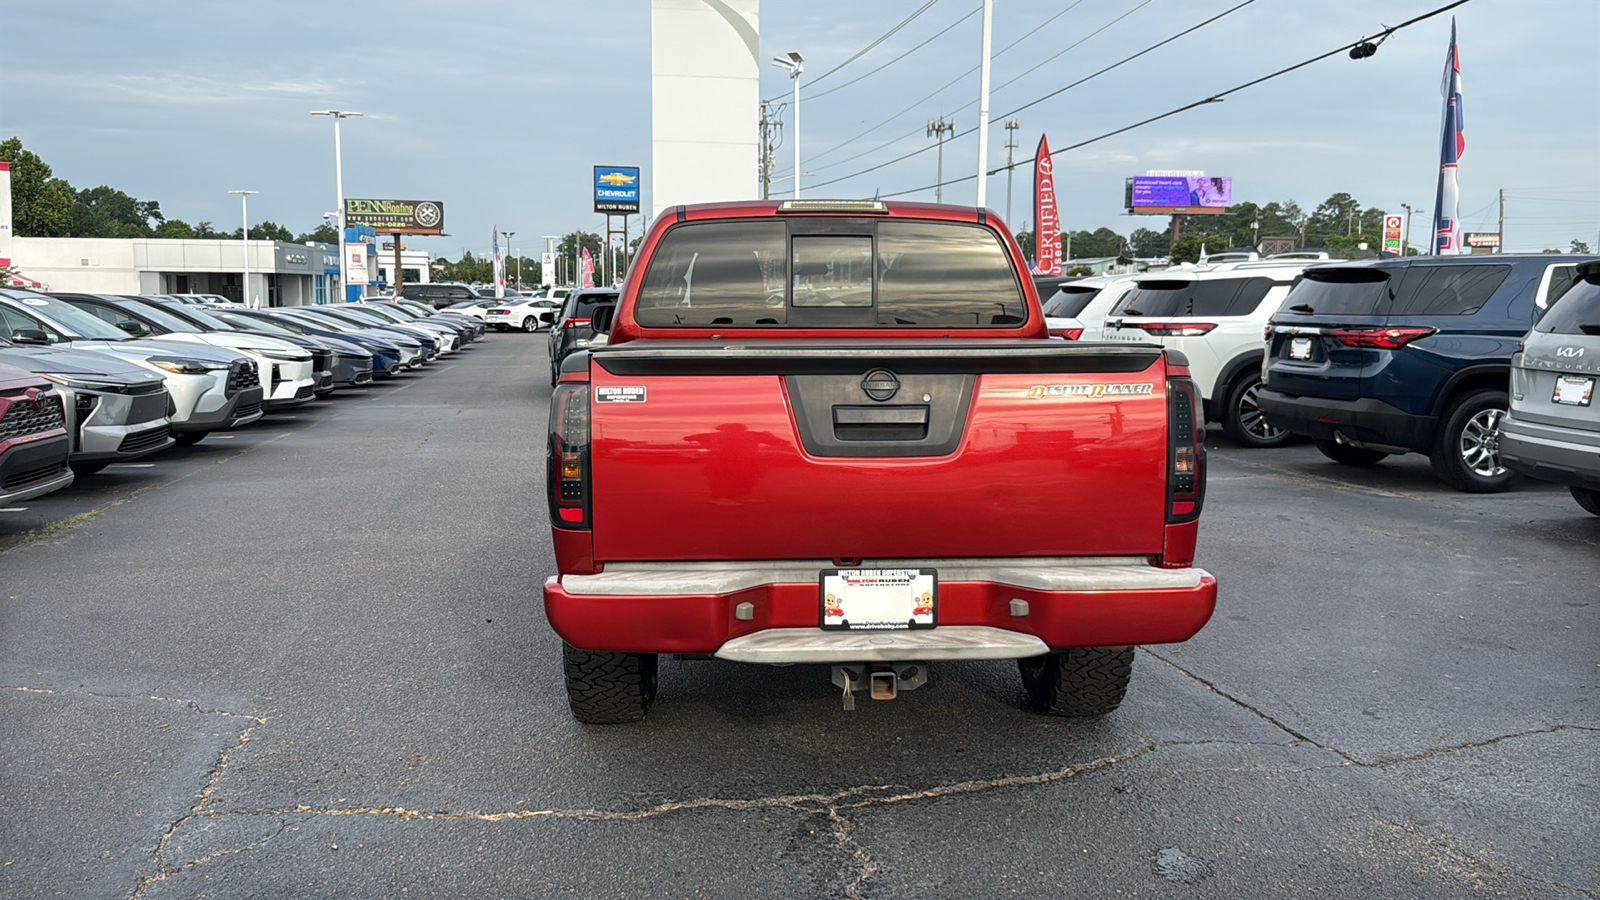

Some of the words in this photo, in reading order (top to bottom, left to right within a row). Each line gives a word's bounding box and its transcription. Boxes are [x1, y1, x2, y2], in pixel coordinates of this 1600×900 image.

[347, 200, 389, 213] PENN
[387, 202, 413, 216] Roofing
[1038, 178, 1053, 274] CERTIFIED
[1556, 347, 1585, 358] KIA
[1030, 385, 1089, 398] DESERT
[1090, 384, 1152, 397] RUNNER
